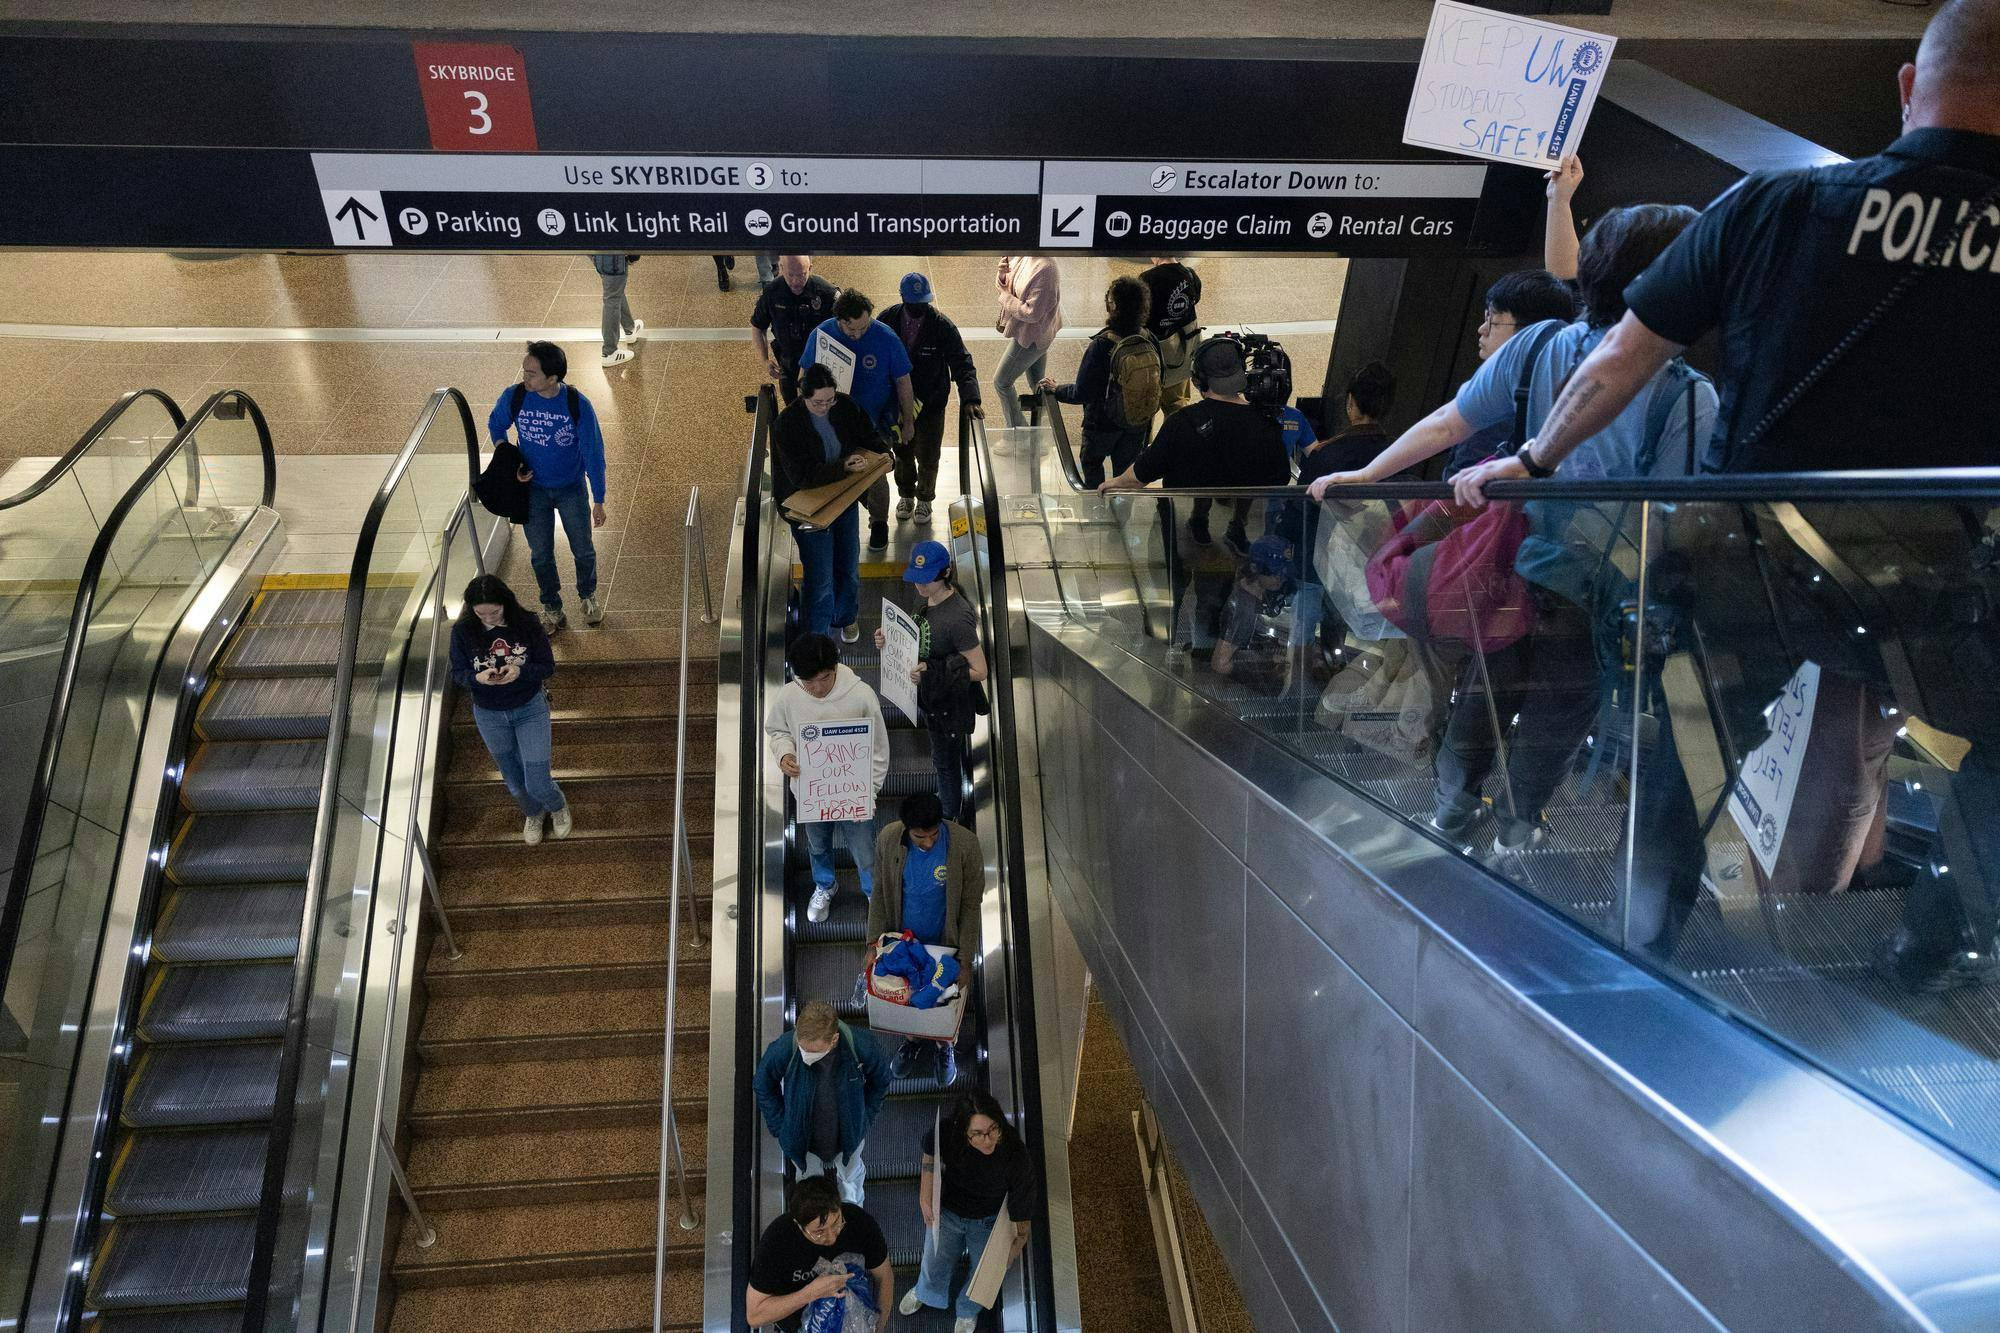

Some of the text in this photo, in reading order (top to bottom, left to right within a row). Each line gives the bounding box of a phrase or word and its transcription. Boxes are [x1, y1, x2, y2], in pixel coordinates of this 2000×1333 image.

[1434, 14, 1574, 88] KEEP UW
[428, 64, 516, 82] SKYBRIDGE
[463, 90, 493, 135] 3
[1421, 80, 1527, 121] STUDENTS
[1548, 83, 1582, 157] UAW Local 4121
[1459, 119, 1548, 160] SAFE!
[564, 165, 809, 187] Use SKYBRIDGE 3 to:
[1185, 169, 1380, 192] Escalator Down to:
[436, 211, 522, 238] Parking
[574, 211, 616, 234] Link
[626, 211, 682, 239] Light
[690, 211, 728, 234] Rail
[780, 212, 859, 235] Ground
[866, 212, 1021, 240] Transportation
[1139, 212, 1454, 242] Baggage Claim Rental Cars
[1846, 188, 2000, 273] POLIC
[518, 409, 570, 423] An injury
[532, 419, 554, 427] one
[824, 728, 838, 736] UAW
[838, 727, 854, 735] Local
[804, 740, 870, 769] BRING
[822, 763, 856, 779] OUR
[809, 779, 867, 797] FELLOW
[820, 806, 868, 820] HOME
